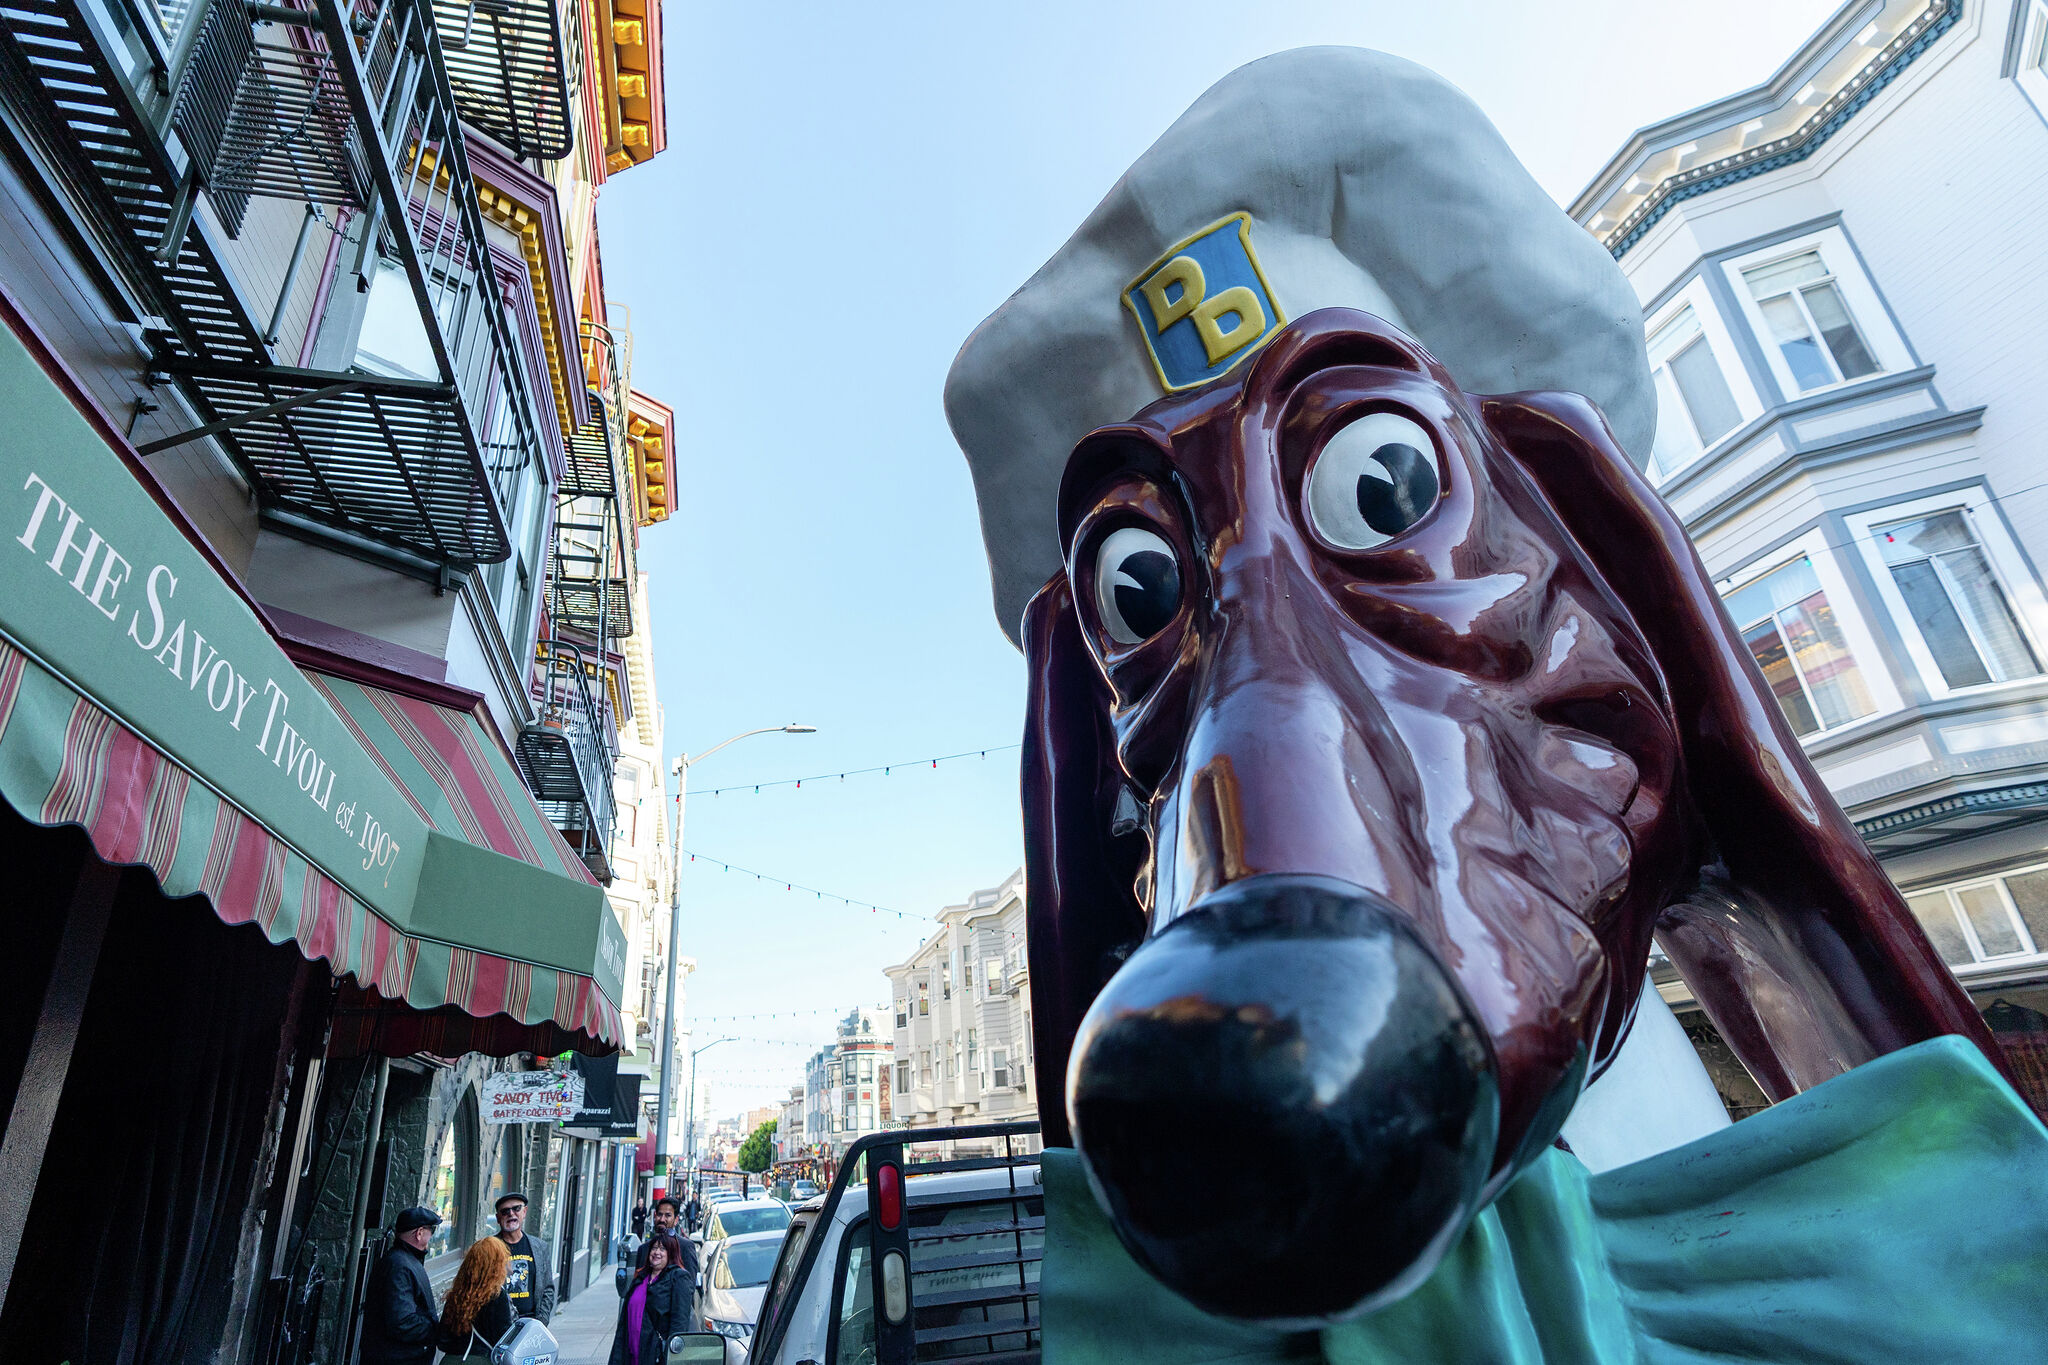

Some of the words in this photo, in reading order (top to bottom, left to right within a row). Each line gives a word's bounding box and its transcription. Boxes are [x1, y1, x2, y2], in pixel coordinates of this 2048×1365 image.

[16, 472, 131, 621] THE
[128, 565, 257, 731] SAVOY
[255, 677, 337, 813] TIVOLI
[335, 801, 356, 839] est.
[357, 812, 400, 889] 1907
[493, 1092, 533, 1105] SAVOY
[538, 1090, 574, 1103] TIVOLI
[879, 1065, 891, 1120] MARKET
[582, 1107, 612, 1116] aparazzi
